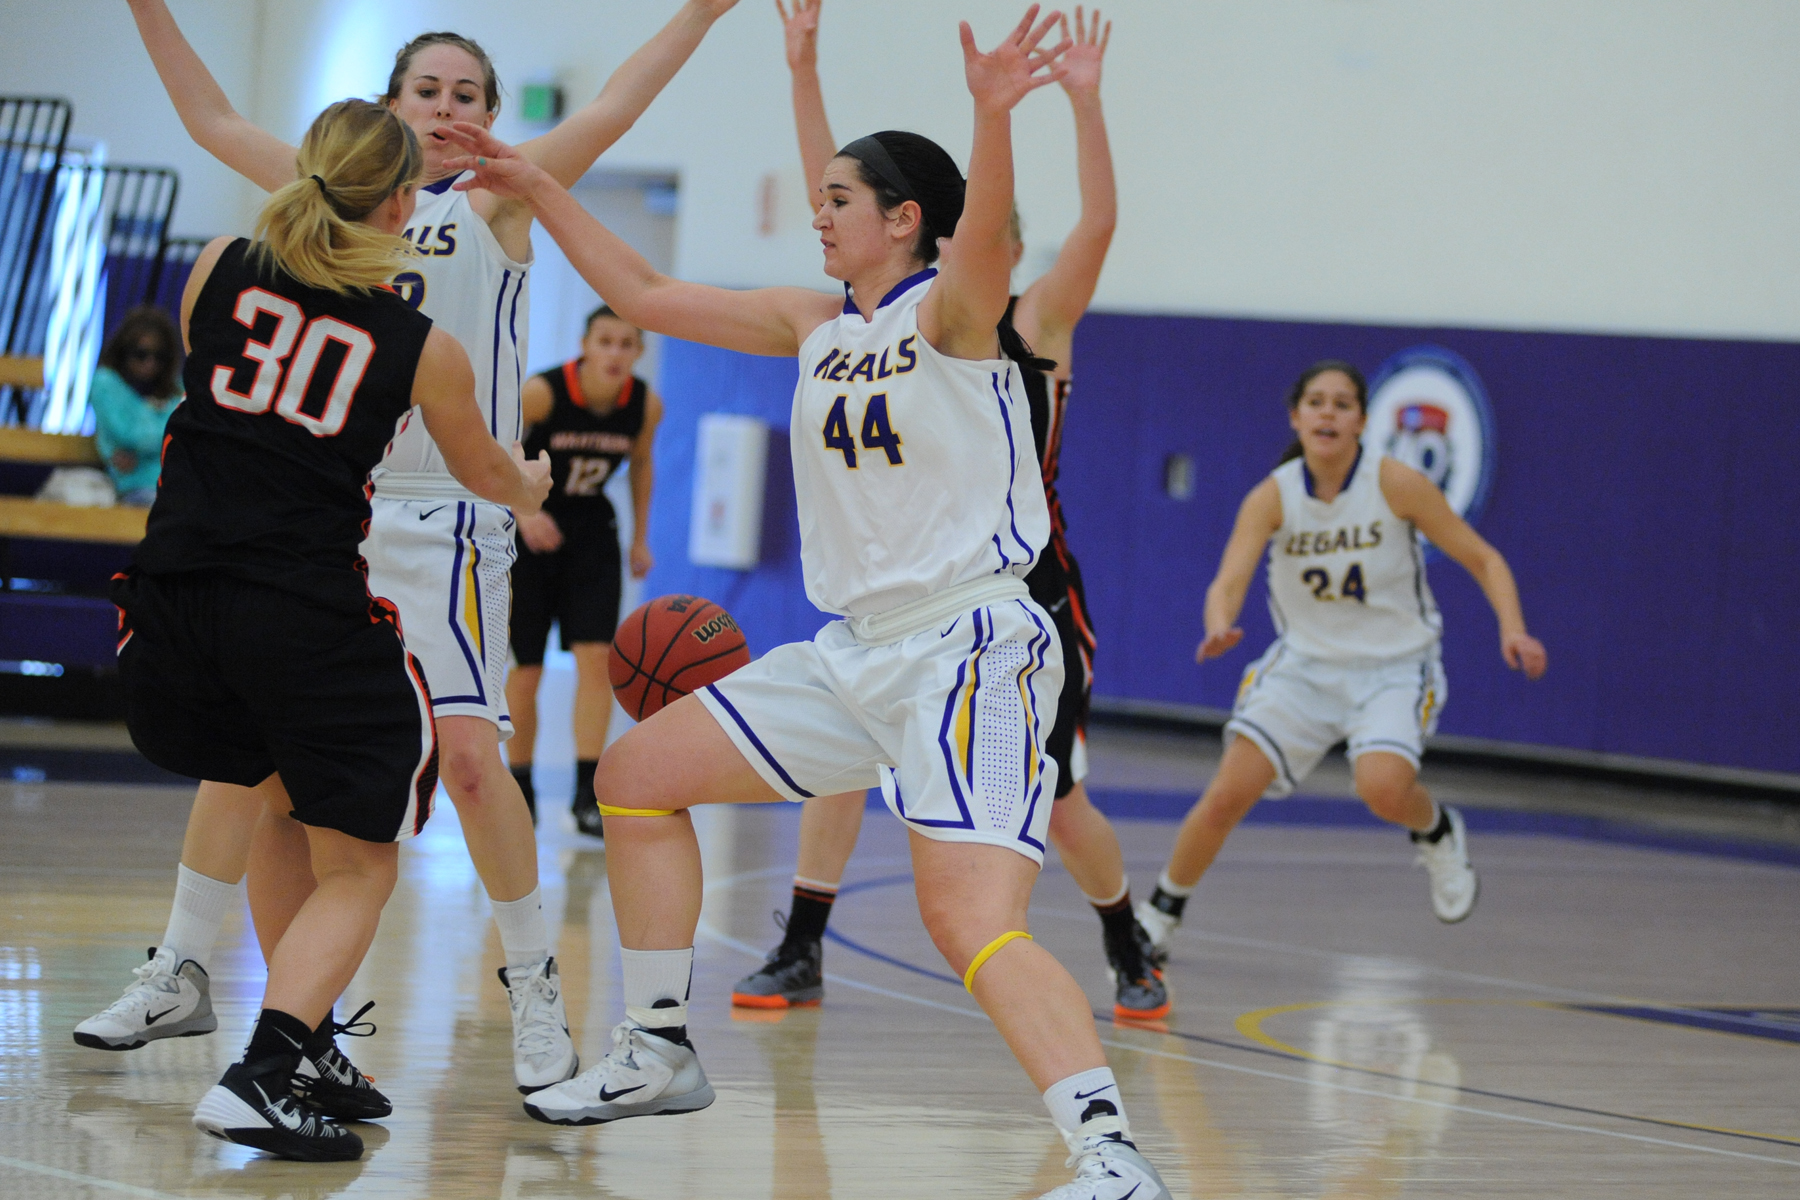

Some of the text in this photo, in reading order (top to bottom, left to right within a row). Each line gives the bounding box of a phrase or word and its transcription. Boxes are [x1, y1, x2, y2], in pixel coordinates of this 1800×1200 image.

[210, 286, 376, 437] 30
[822, 391, 905, 470] 44
[564, 456, 611, 496] 12
[1301, 562, 1368, 605] 24
